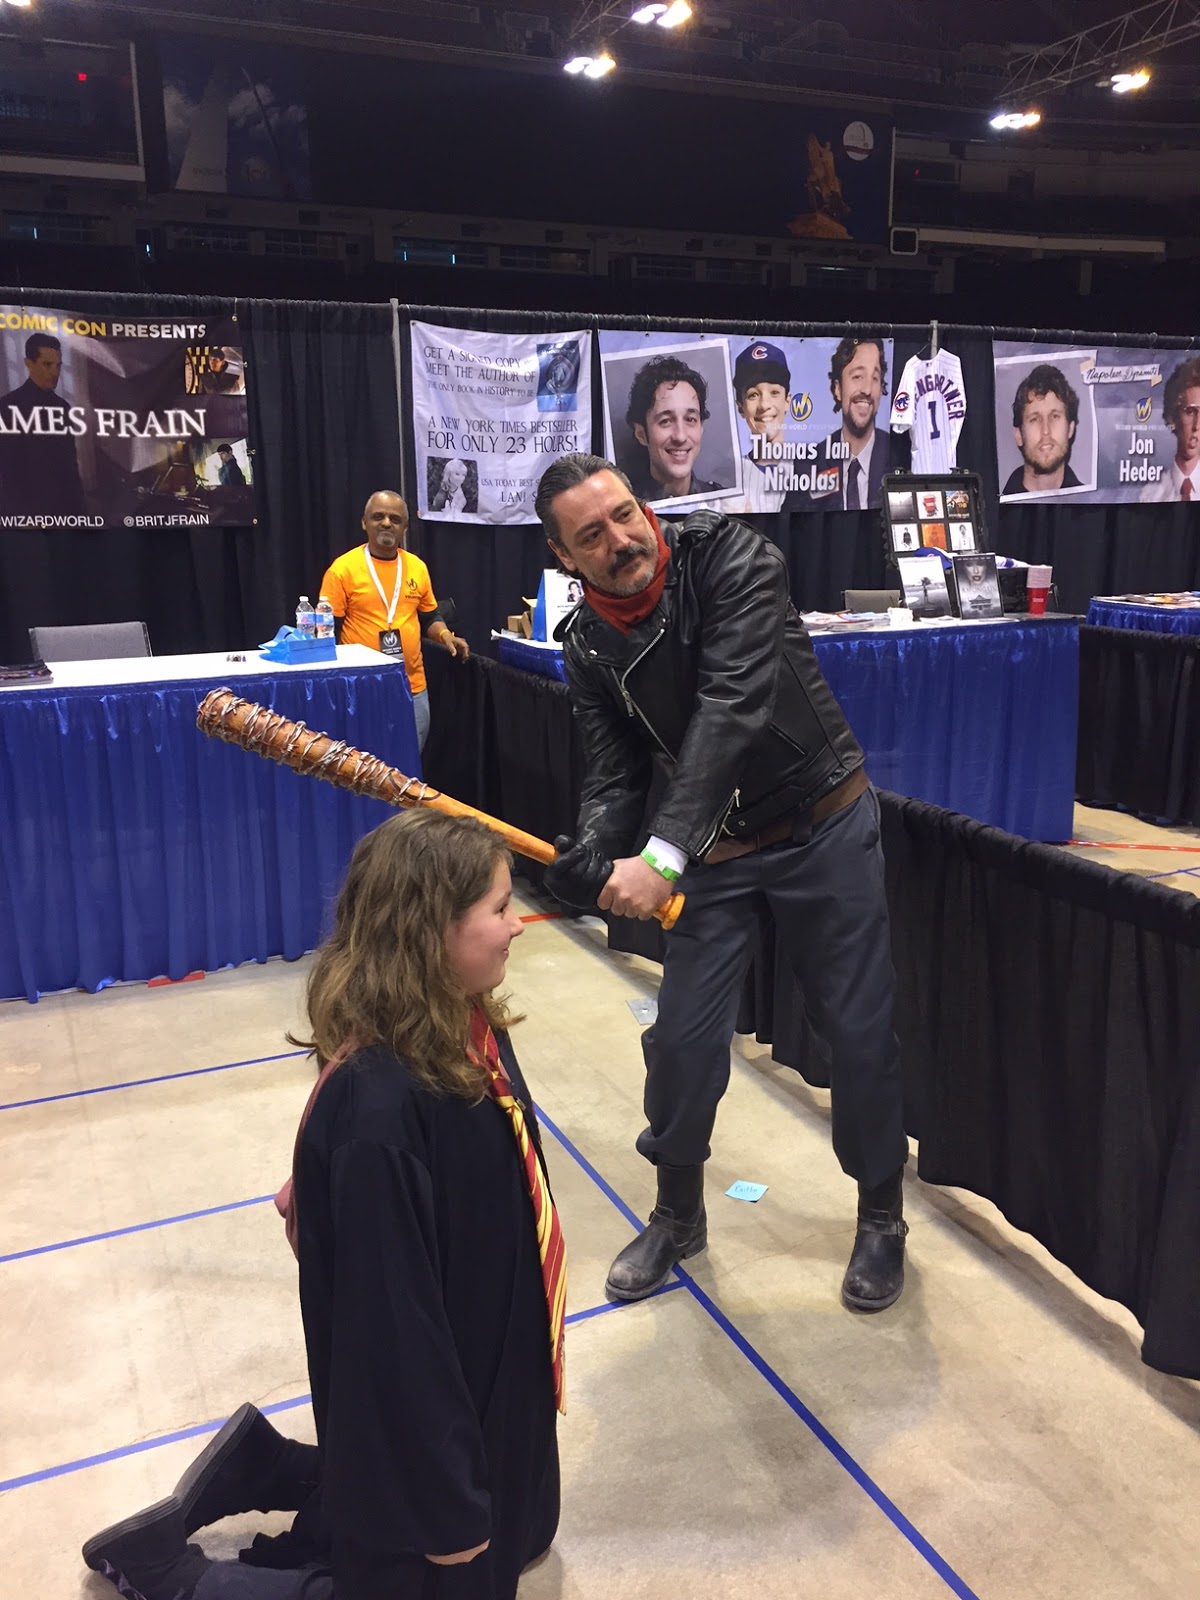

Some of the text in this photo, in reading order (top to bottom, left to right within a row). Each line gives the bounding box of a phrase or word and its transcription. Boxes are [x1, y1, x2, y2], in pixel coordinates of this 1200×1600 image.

[62, 319, 106, 336] CON
[111, 323, 206, 339] PRESENTS
[424, 346, 443, 359] GET
[448, 349, 455, 361] A
[496, 357, 520, 368] COPY
[455, 365, 473, 379] THE
[478, 368, 519, 382] AUTHOR
[524, 371, 536, 383] OF
[438, 382, 455, 392] ONLY
[457, 385, 475, 394] BOOK
[485, 387, 516, 396] HISTORY
[94, 408, 207, 437] FRAIN
[428, 416, 578, 434] A NEW YORK TIMES BESTSELLER
[928, 401, 940, 440] 1
[427, 430, 579, 454] FOR ONLY 23 HOURS!
[750, 432, 850, 460] Thomas Ian
[1128, 431, 1154, 455] Jon
[764, 464, 837, 492] Nicholas
[1119, 458, 1163, 482] Heder
[480, 479, 493, 487] USA
[495, 479, 516, 488] TODAY
[519, 479, 533, 487] BEST
[501, 491, 527, 503] LANI
[0, 514, 210, 528] WIZARDWORLD @BRITJFRAIN
